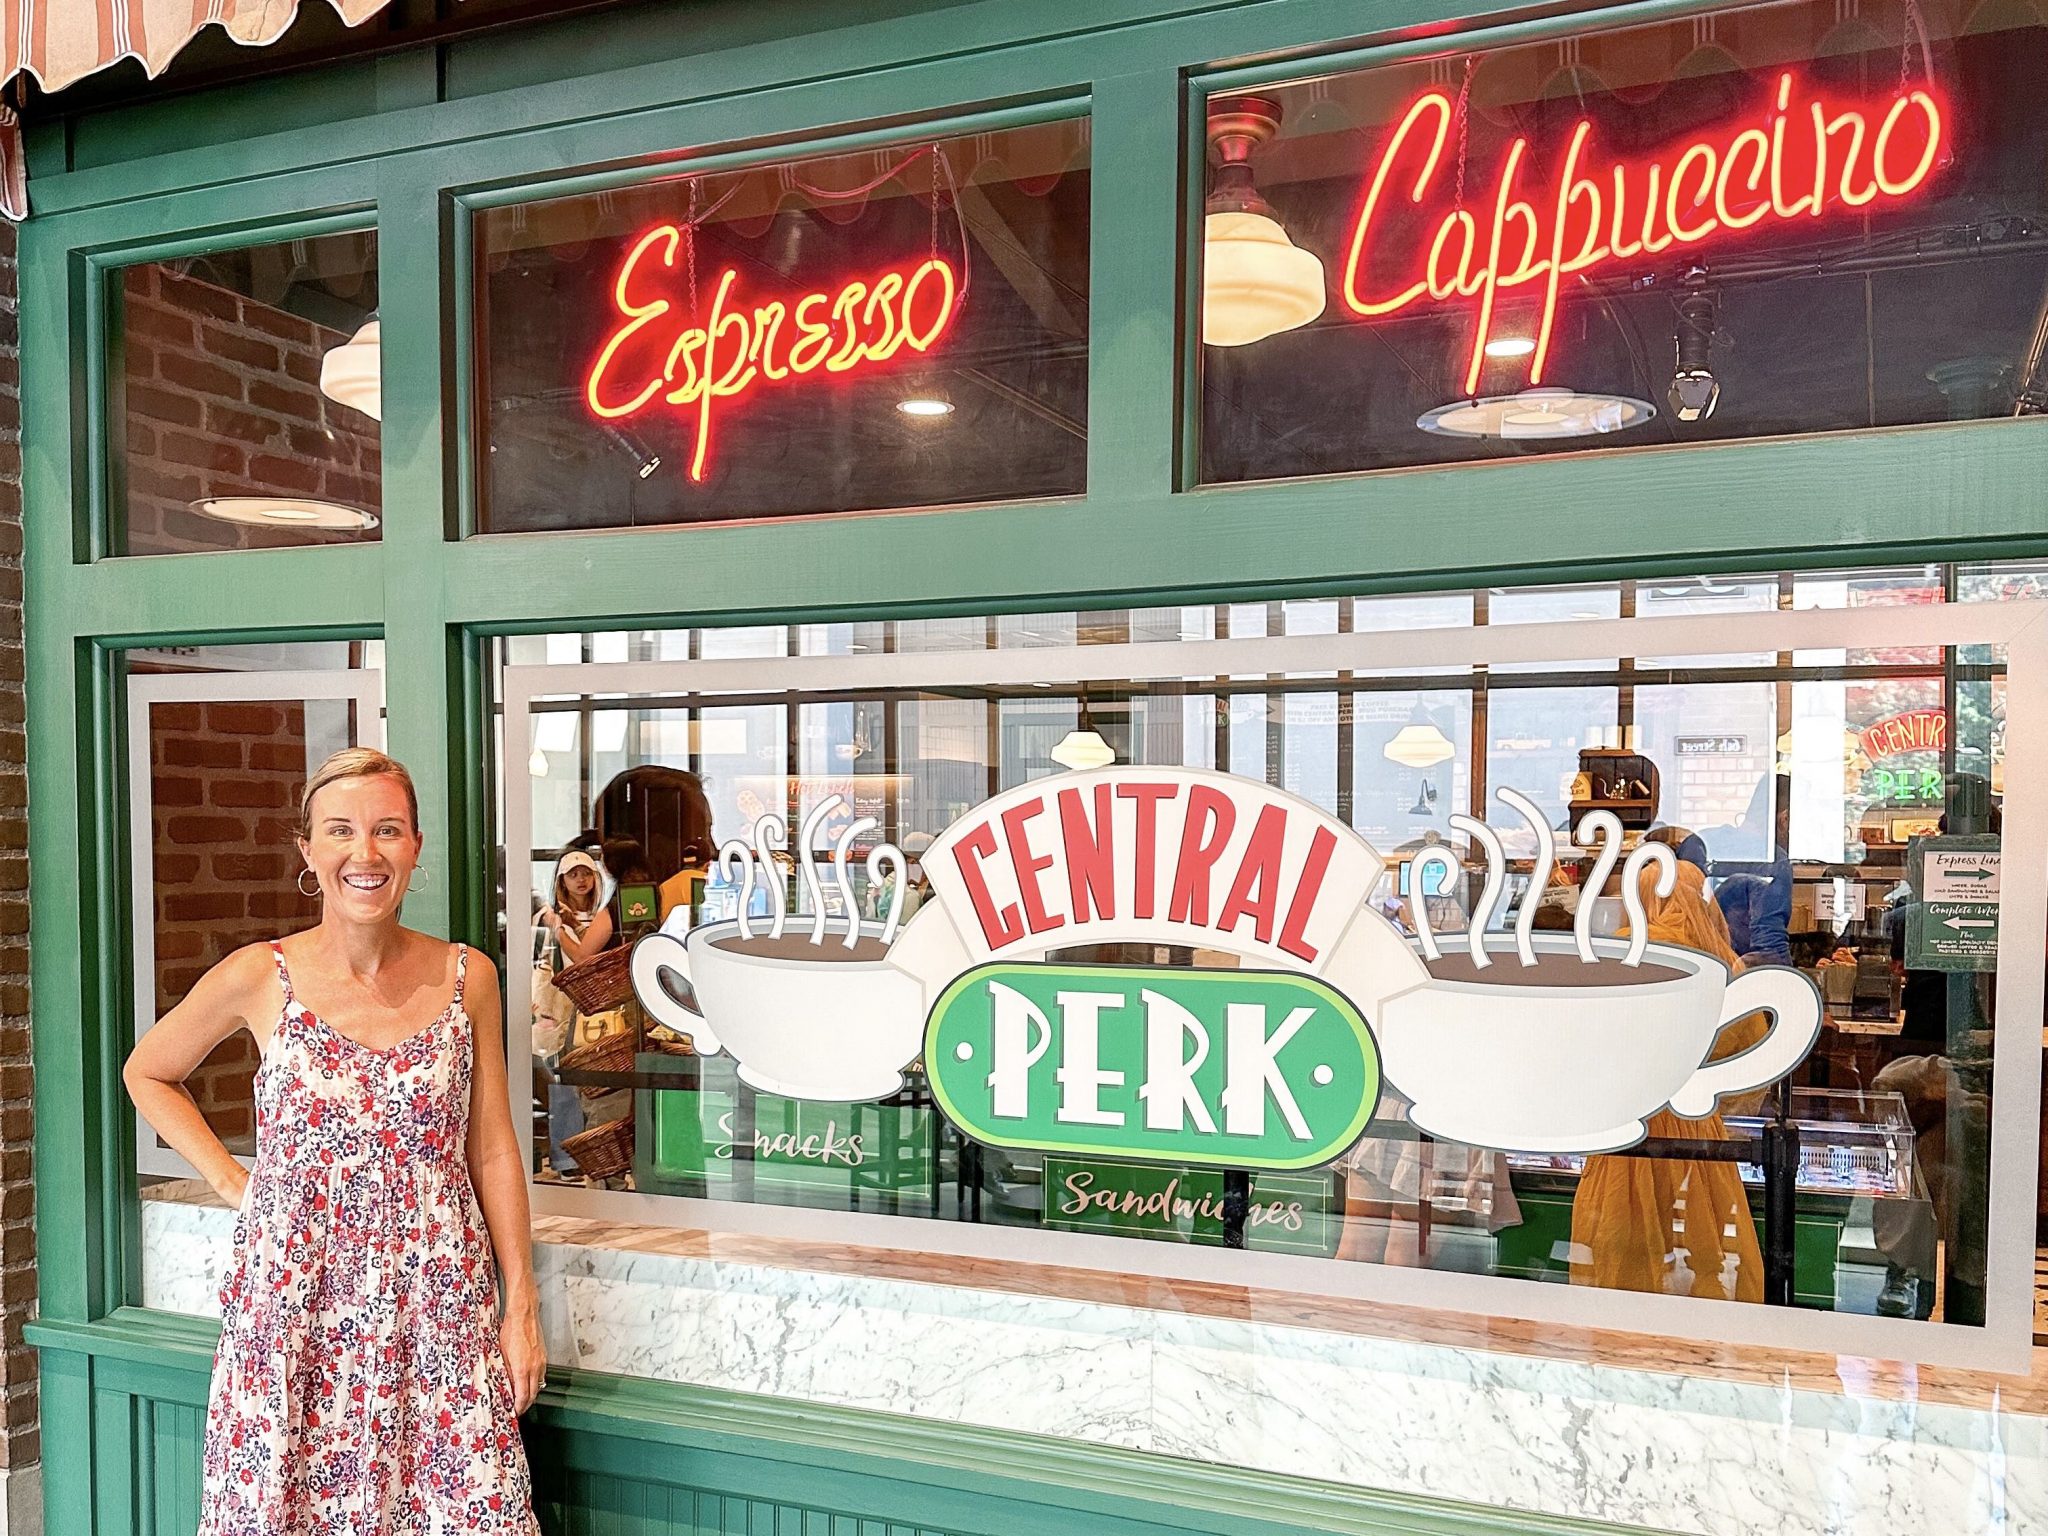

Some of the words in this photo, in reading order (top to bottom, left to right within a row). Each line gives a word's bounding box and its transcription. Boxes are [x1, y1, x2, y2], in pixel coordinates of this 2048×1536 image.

[1344, 73, 1941, 396] Cappuccino
[588, 225, 955, 481] Espresso
[1869, 714, 1946, 757] CENTR
[1874, 768, 1944, 800] PER
[951, 783, 1338, 964] CENTRAL
[1936, 853, 1977, 868] Express
[1929, 903, 1972, 917] Complete
[1974, 906, 1999, 917] Men
[985, 980, 1318, 1141] PERK
[714, 1111, 863, 1166] Snacks
